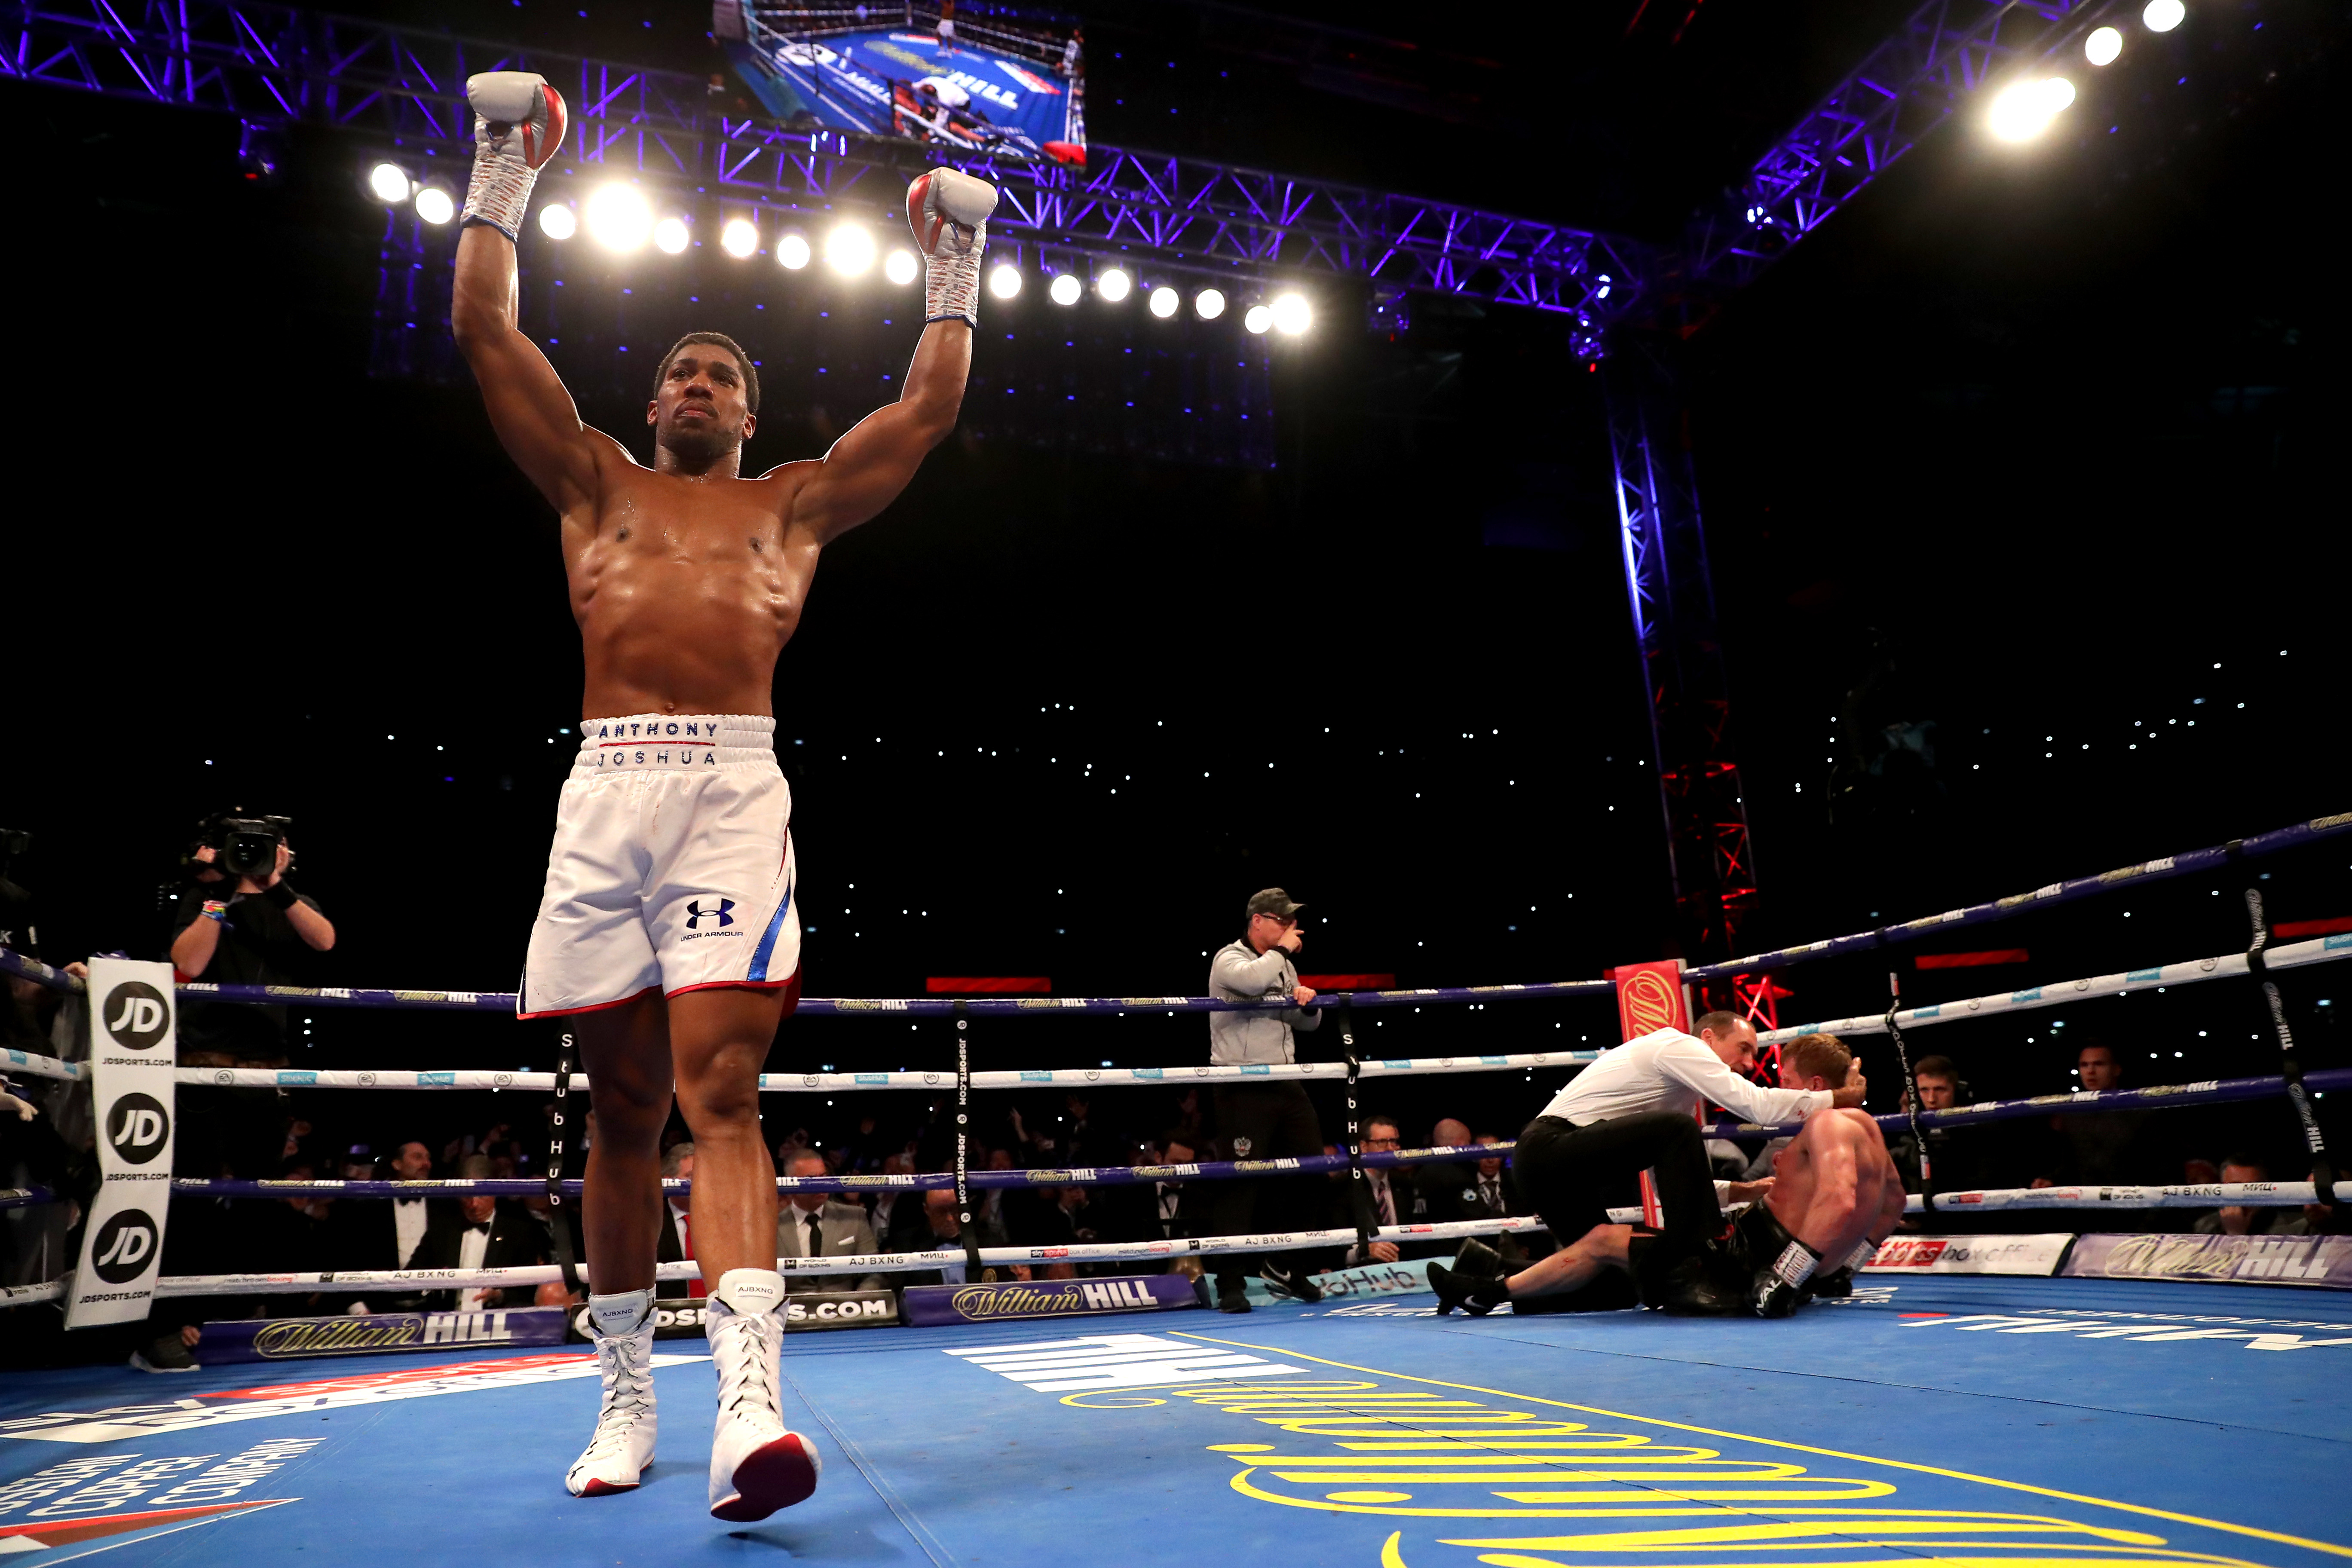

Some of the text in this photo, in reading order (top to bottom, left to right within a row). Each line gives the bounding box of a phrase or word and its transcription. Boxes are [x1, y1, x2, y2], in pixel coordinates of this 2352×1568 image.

[599, 723, 717, 738] ANTHONY
[597, 751, 715, 766] JOSHUA
[681, 933, 702, 942] UNDER
[111, 997, 163, 1033] JD
[881, 999, 907, 1010] HILL
[102, 1058, 172, 1066] JDSPORTS.COM
[959, 1038, 968, 1106] JDSPORTS.COM
[115, 1110, 162, 1145] JD
[549, 1034, 573, 1206] StubHub
[2306, 1126, 2325, 1153] HILL
[957, 1133, 967, 1204] JDSPORTS.COM
[1071, 1169, 1096, 1181] HILL
[1176, 1163, 1200, 1176] HILL
[1275, 1158, 1300, 1169] HILL
[105, 1173, 168, 1181] JDSPORTS.COM
[661, 1178, 682, 1188] ILL
[888, 1175, 915, 1186] HILL
[2184, 1187, 2222, 1196] BXNG
[98, 1226, 151, 1266] JD
[1263, 1235, 1292, 1243] BXNG
[2236, 1241, 2331, 1278] HILL
[738, 1286, 774, 1295] AJBXNG
[1320, 1267, 1417, 1296] bHub
[79, 1291, 151, 1305] JDSPORTS.COM
[952, 1280, 1158, 1320] William HILL
[602, 1308, 634, 1317] AJBXNG
[2017, 1308, 2352, 1331] ВЕЛОПМЕНТ
[253, 1312, 511, 1358] William HILL
[941, 1333, 1311, 1393] HILL
[0, 1354, 586, 1430] sky sports
[99, 1363, 604, 1428] box offic
[147, 1437, 328, 1504] COMPANY
[27, 1454, 220, 1516] COPPER
